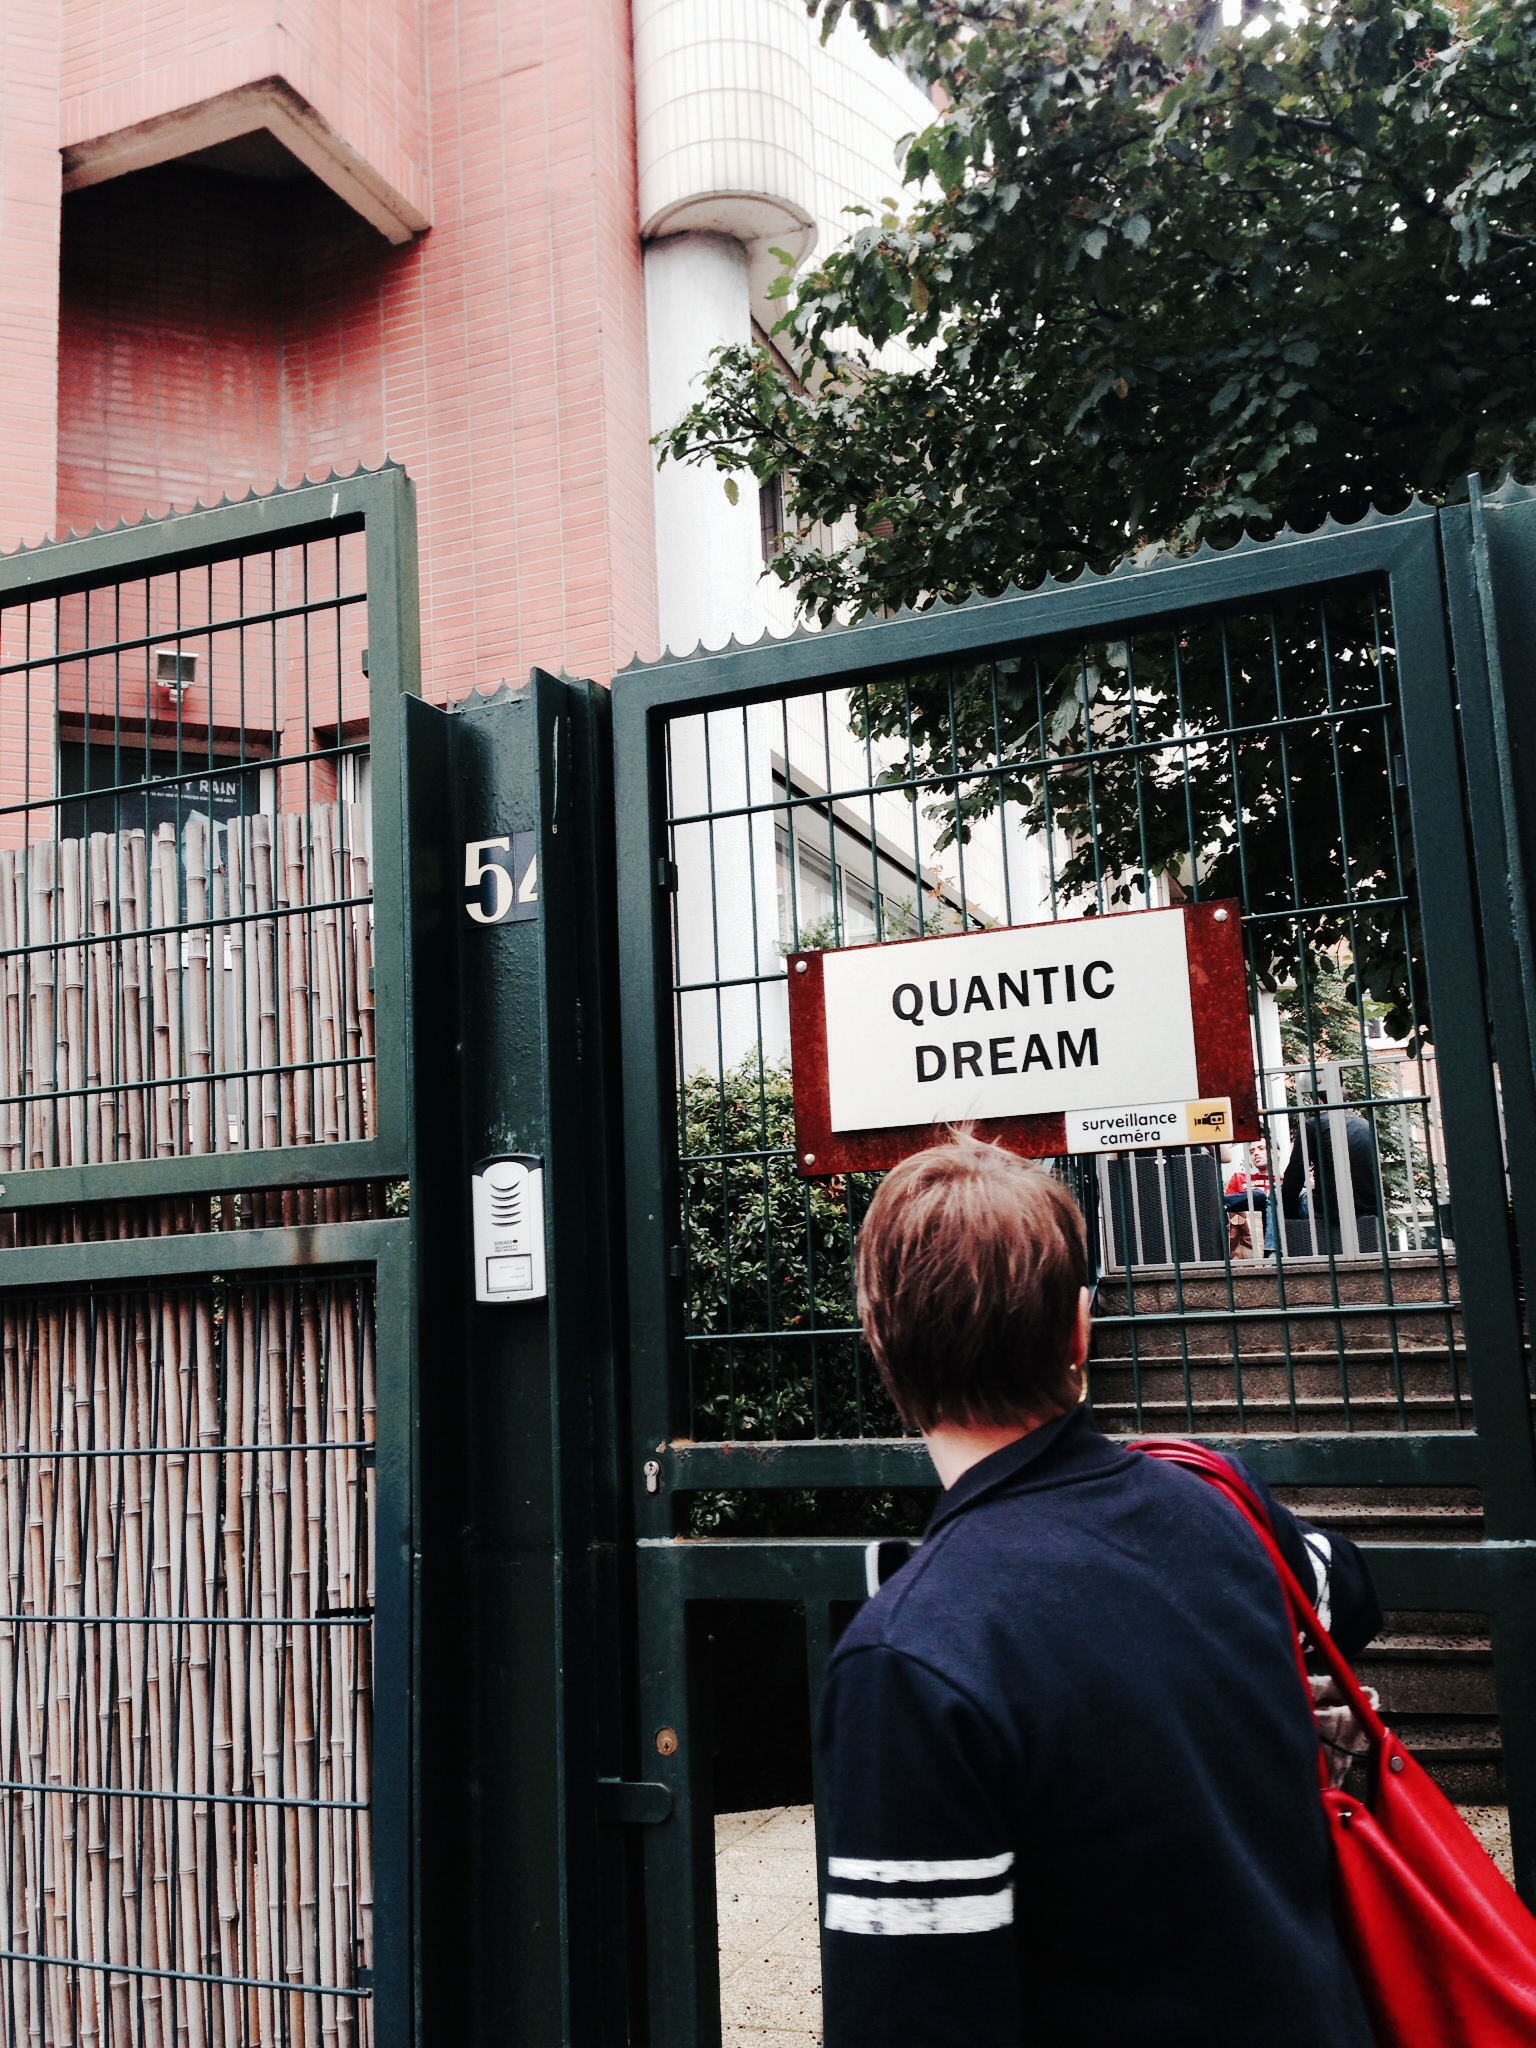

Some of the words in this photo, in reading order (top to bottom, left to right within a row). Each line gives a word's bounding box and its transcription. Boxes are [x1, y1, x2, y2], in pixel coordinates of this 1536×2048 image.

[199, 780, 236, 796] RAIN
[892, 960, 1115, 1027] QUANTIC
[915, 1027, 1099, 1083] DREAM
[1082, 1113, 1177, 1131] surveillance
[1100, 1129, 1161, 1145] caméra
